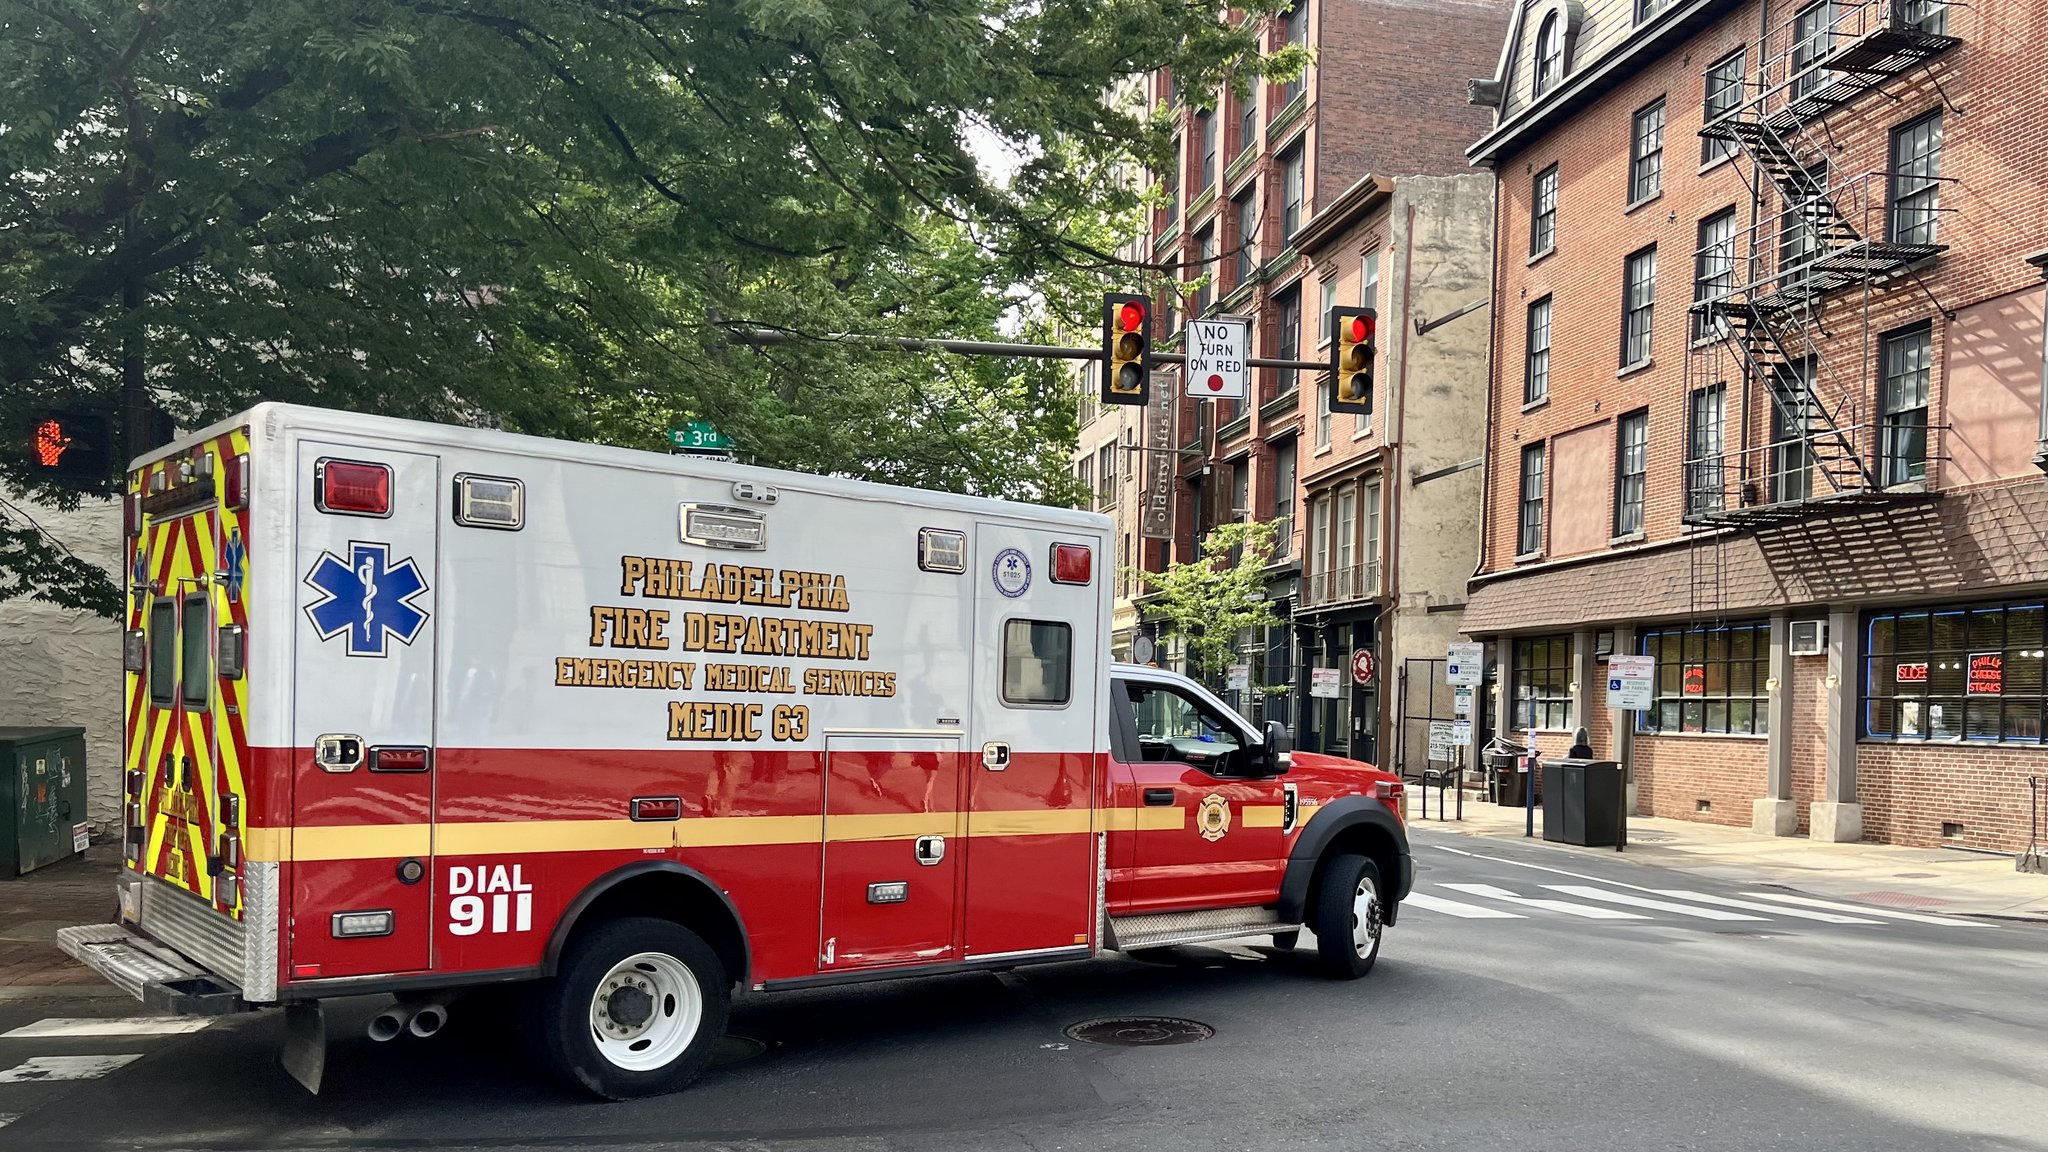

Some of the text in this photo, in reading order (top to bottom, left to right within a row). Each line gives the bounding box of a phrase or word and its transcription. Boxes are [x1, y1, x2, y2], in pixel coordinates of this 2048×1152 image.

[1205, 325, 1228, 340] NO
[1200, 343, 1233, 357] TURN
[1191, 359, 1241, 373] ON RED
[692, 430, 717, 446] 3rd
[1151, 381, 1170, 522] oldcitylofts.net
[1003, 571, 1021, 579] 51025
[621, 556, 849, 612] PHILADELPHIA
[590, 605, 873, 660] FIRE DEPARTMENT
[1972, 656, 2002, 669] PHILLY
[555, 657, 897, 697] EMERGENCY MEDICAL SERVICES
[1970, 669, 2002, 680] CHEESE
[1685, 683, 1704, 693] PIZZA
[1970, 682, 2002, 692] STEAKS
[667, 701, 809, 742] MEDIC 63
[449, 864, 533, 895] DIAL
[448, 893, 532, 936] 911
